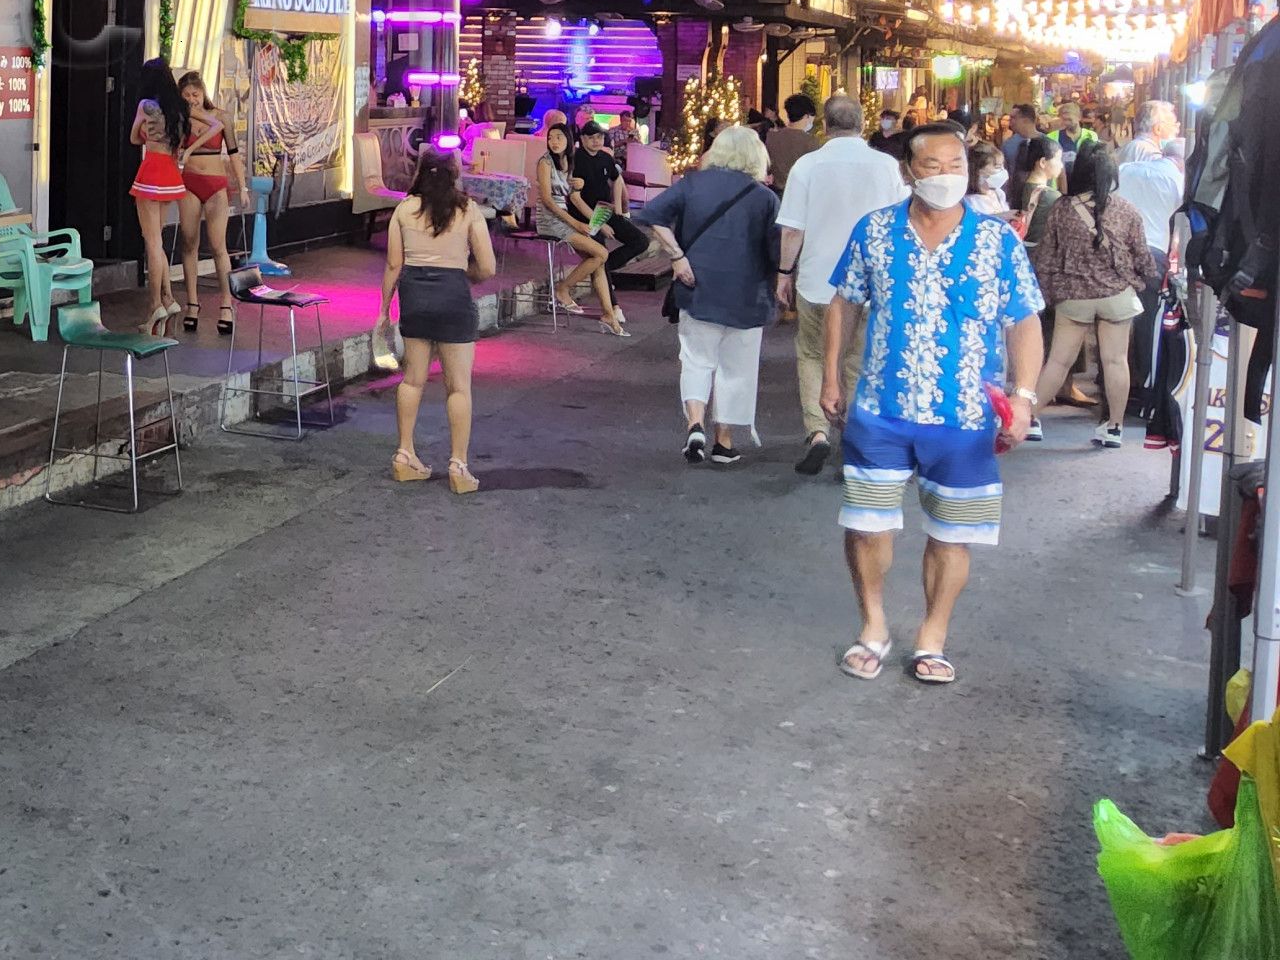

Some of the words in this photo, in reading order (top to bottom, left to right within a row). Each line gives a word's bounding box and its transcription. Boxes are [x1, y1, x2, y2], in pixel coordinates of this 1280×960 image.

[11, 55, 32, 69] 100%
[8, 77, 27, 92] 100%
[8, 98, 31, 113] 100%
